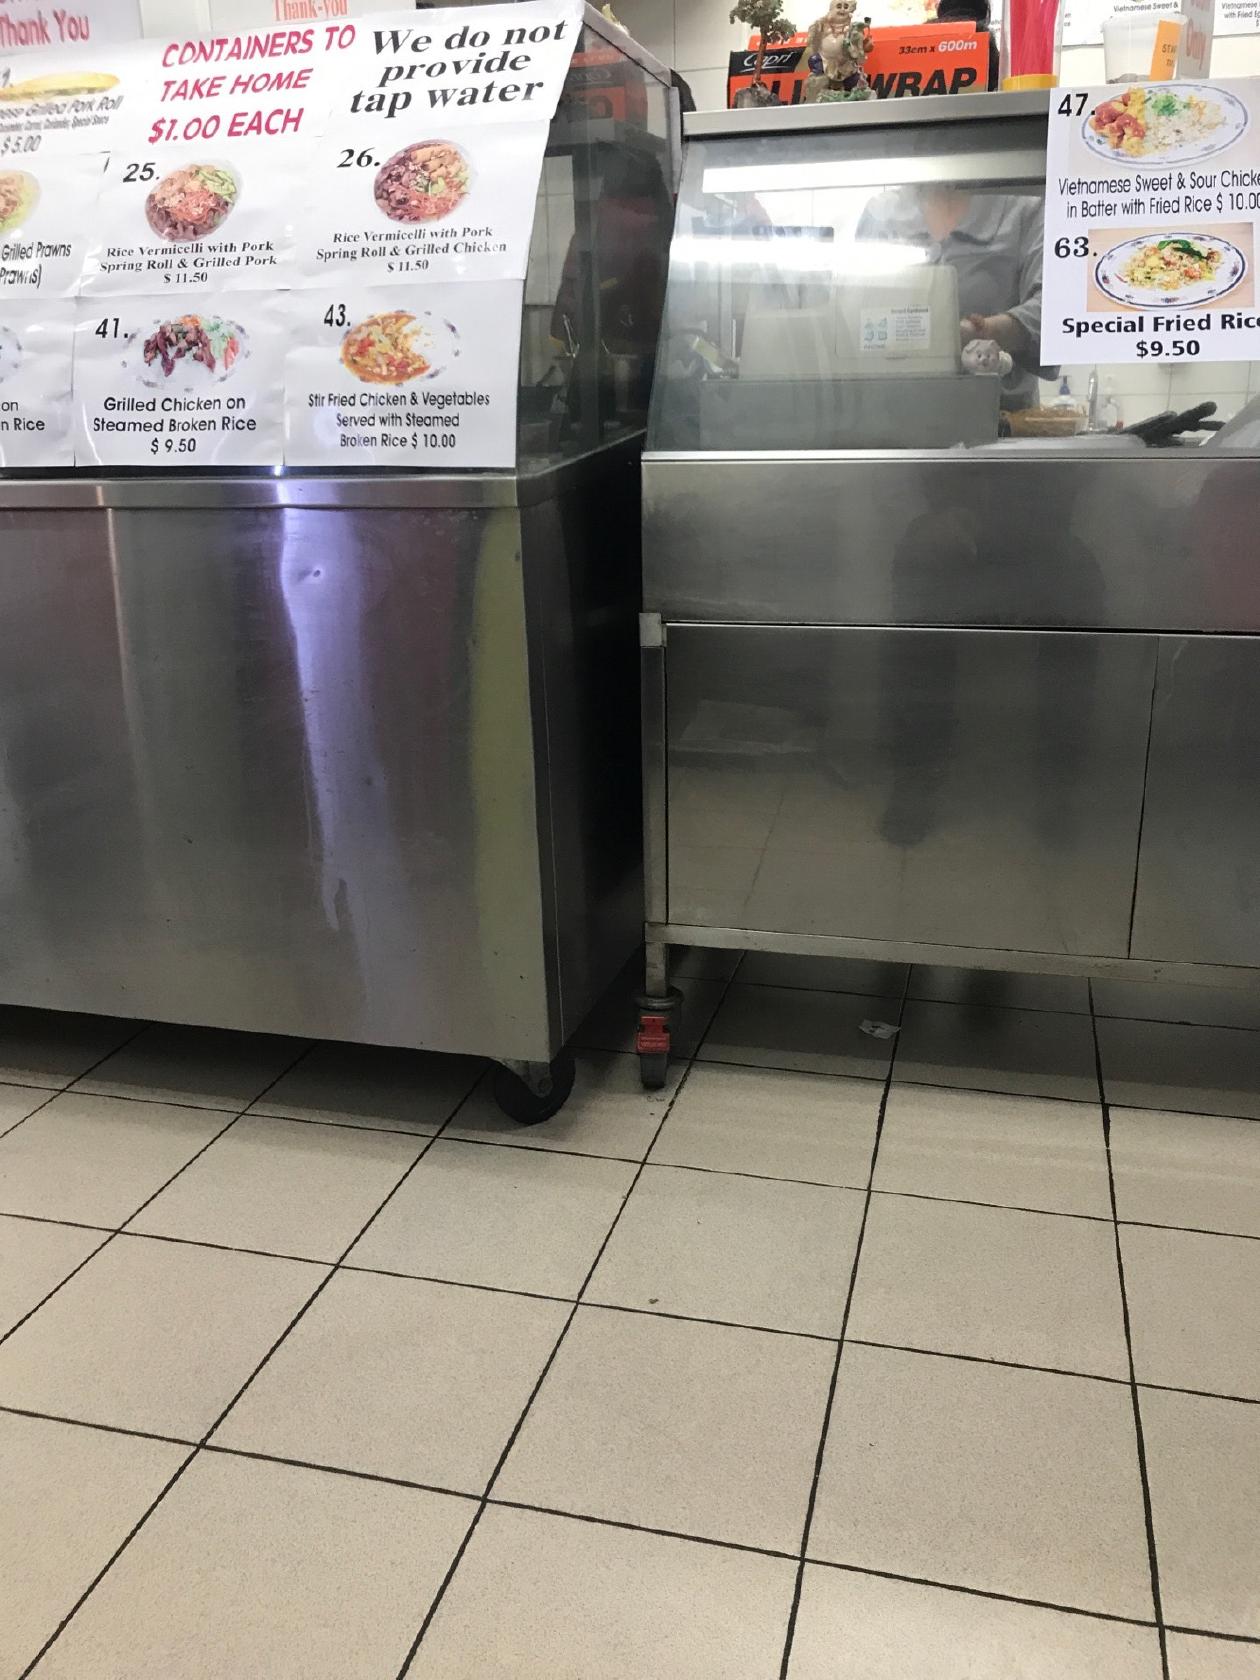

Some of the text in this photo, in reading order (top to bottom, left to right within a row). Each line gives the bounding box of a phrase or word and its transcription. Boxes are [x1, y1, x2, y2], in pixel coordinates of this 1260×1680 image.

[0, 9, 90, 48] Thank You
[372, 19, 568, 56] We do not
[162, 25, 356, 68] CONTAINERS TO
[898, 45, 927, 54] 33cm
[938, 39, 977, 52] 600m
[378, 50, 532, 88] provide
[160, 68, 313, 102] TAKE HOME
[868, 67, 978, 99] WRAP
[350, 81, 544, 118] tap water
[1057, 92, 1096, 117] 47.
[148, 108, 304, 144] $1.00 EACH
[11, 135, 42, 154] 5.00
[337, 148, 381, 169] 26.
[122, 162, 160, 183] 25.
[1058, 178, 1131, 195] Vietnamese
[1135, 172, 1173, 192] Sweet
[1177, 172, 1186, 190] &
[1190, 171, 1217, 189] Sour
[1067, 203, 1077, 218] in
[1081, 198, 1117, 217] Batter
[1121, 197, 1146, 215] with
[1149, 195, 1180, 214] Fried
[1185, 195, 1212, 213] Rice
[1216, 192, 1223, 213] $
[333, 227, 493, 244] Rice Vermicelli with Pork
[2, 241, 72, 261] Grilled Prawns
[106, 241, 275, 258] Rice Vermicelli with Pork
[316, 248, 358, 262] Spring
[361, 246, 386, 258] Roll
[389, 246, 401, 257] &
[405, 243, 450, 256] Grilled
[1054, 237, 1098, 258] 63.
[100, 254, 278, 274] Spring Roll & Grilled Pork
[387, 260, 429, 273] $ 11.50
[163, 272, 208, 285] $ 11.50
[324, 304, 351, 327] 43.
[1062, 316, 1144, 337] Special
[1153, 314, 1211, 332] Fried
[95, 318, 129, 339] 41.
[1136, 340, 1201, 357] $9.50
[1, 401, 19, 411] on
[103, 396, 246, 412] Grilled Chicken on
[308, 392, 490, 409] Stir Fried Chicken & Vegetables
[14, 417, 46, 431] Rice
[93, 416, 257, 432] Steamed Broken Rice
[336, 413, 460, 427] Served with Steamed
[150, 438, 196, 455] $ 9.50
[340, 432, 456, 449] Broken Rice $ 10.00
